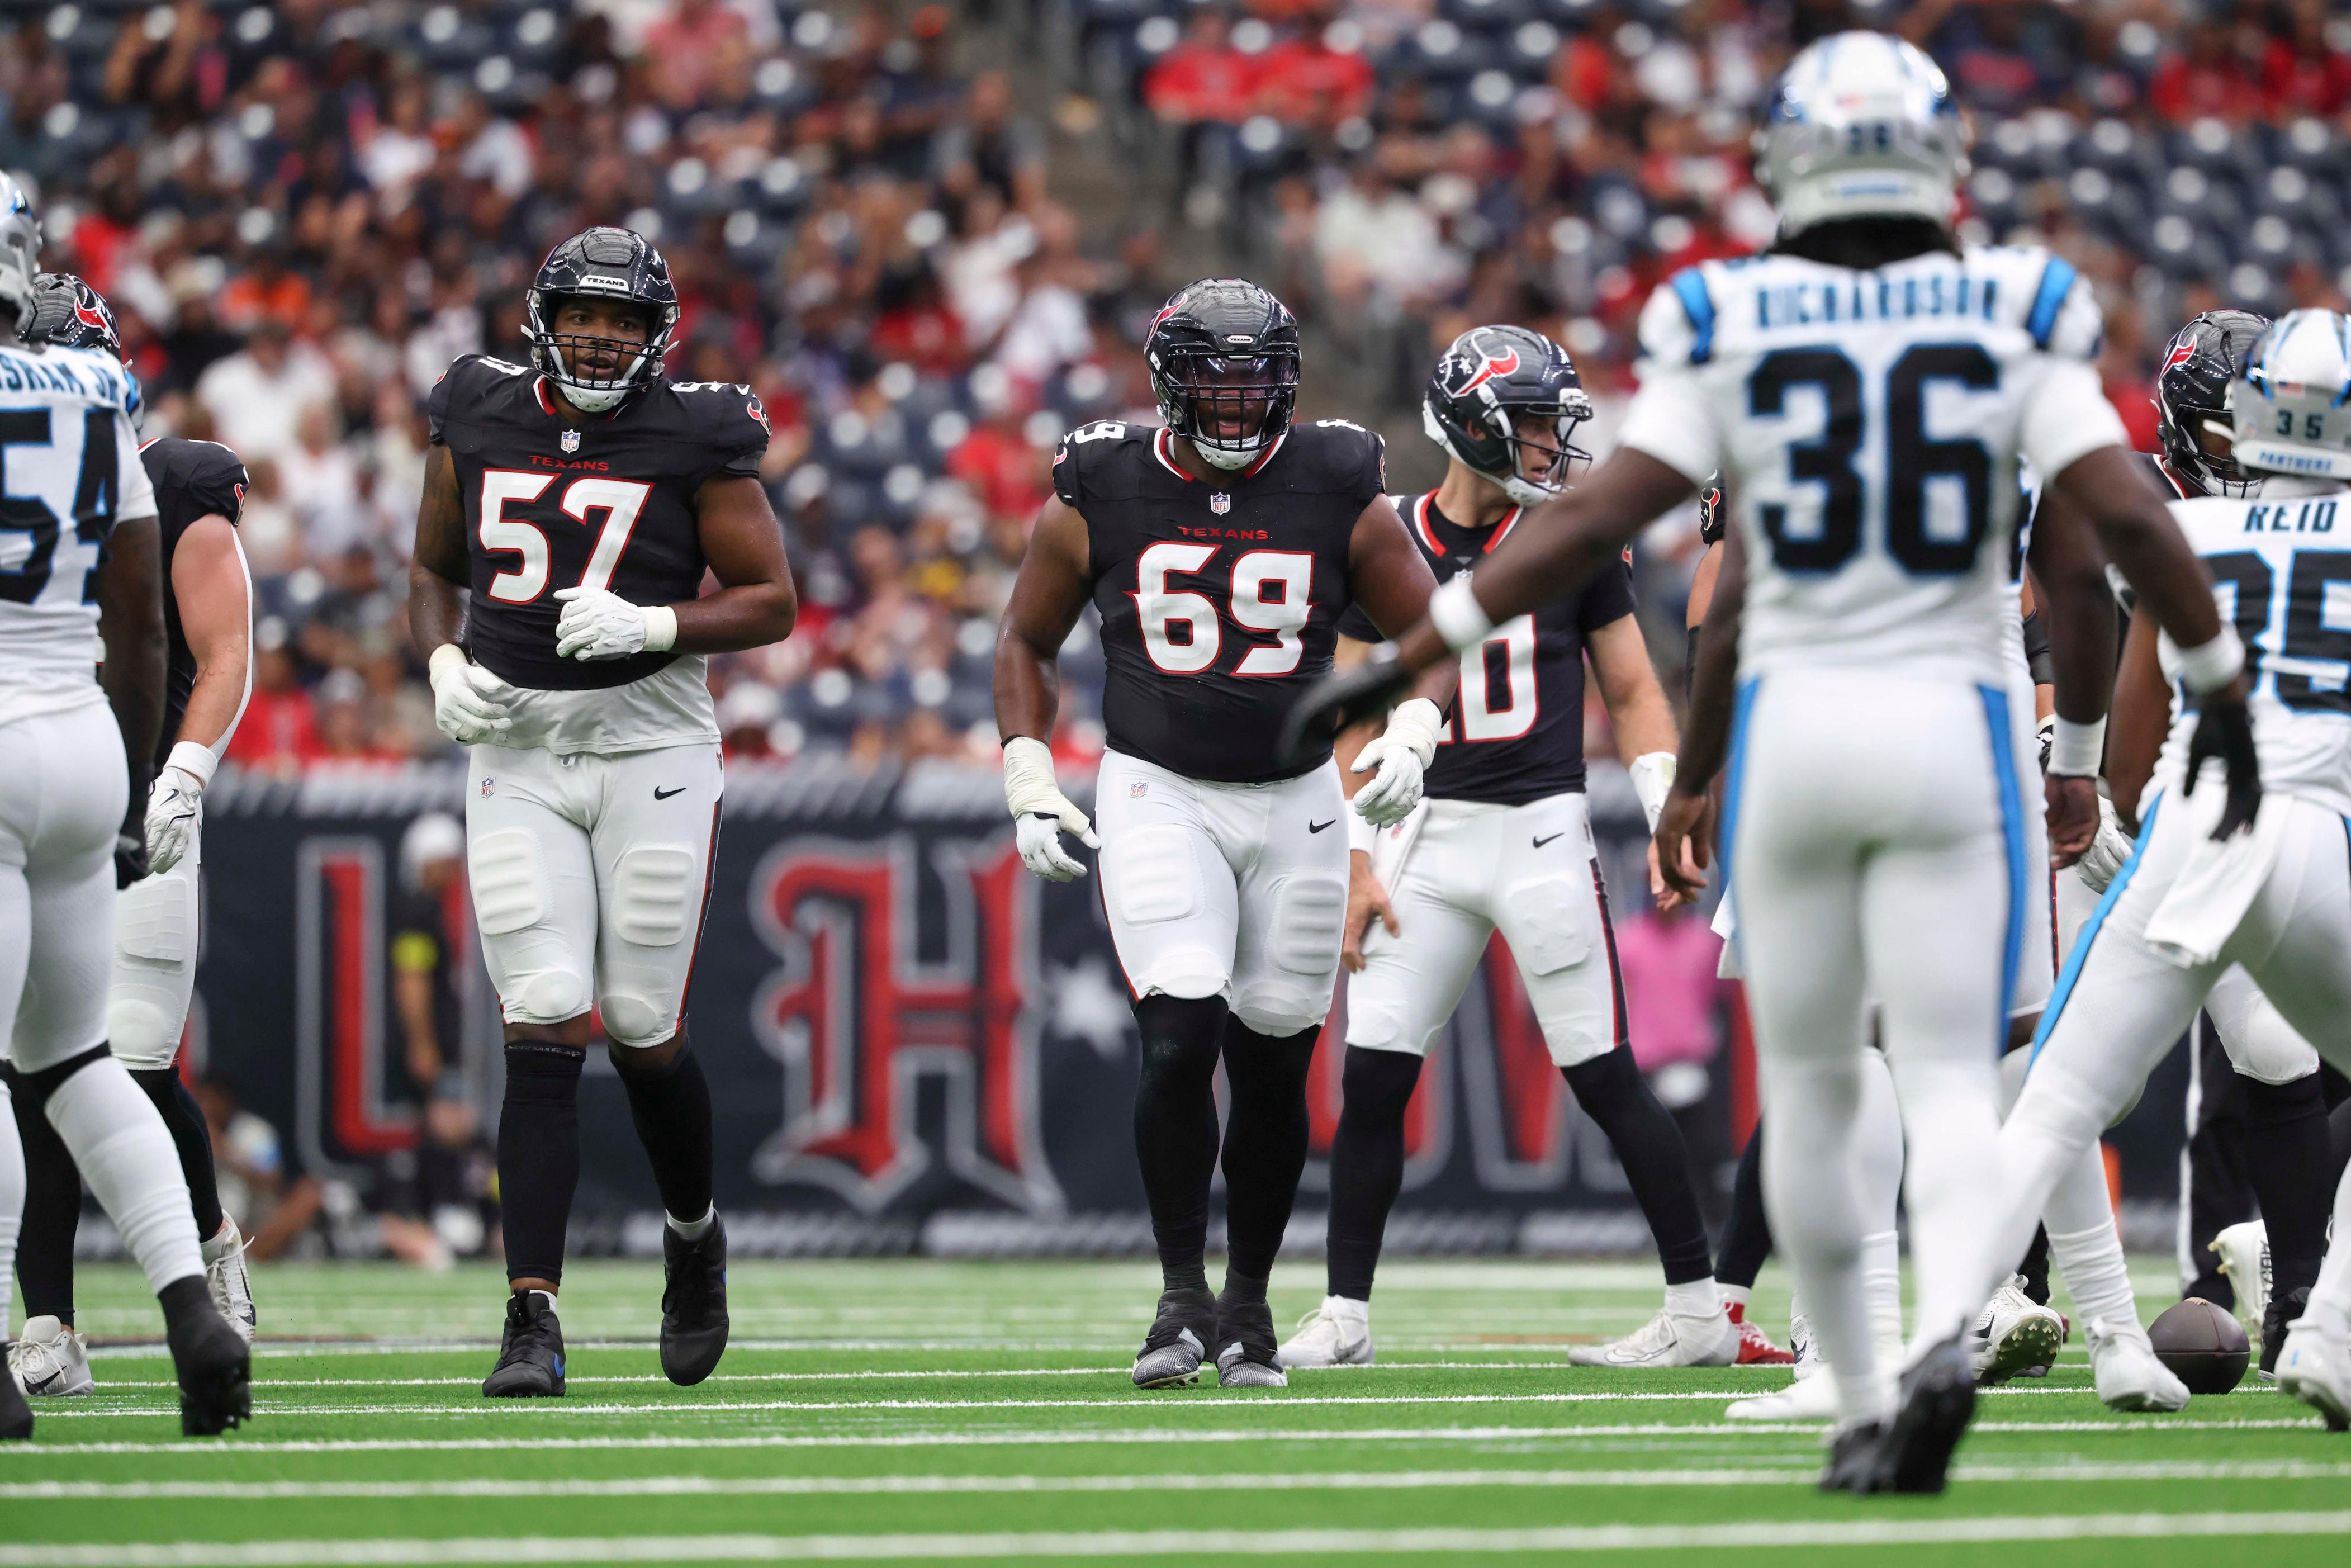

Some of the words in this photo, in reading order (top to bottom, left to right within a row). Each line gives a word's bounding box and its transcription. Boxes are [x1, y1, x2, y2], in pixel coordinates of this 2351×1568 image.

[586, 278, 624, 286] TEXANS
[1757, 274, 1997, 328] RICHARDSON
[0, 352, 86, 395] SHAM
[2276, 409, 2324, 440] 35
[563, 439, 576, 449] NFL
[1747, 343, 2001, 575] 36
[2260, 451, 2333, 472] PANTHERS
[529, 456, 610, 471] TEXANS
[0, 406, 120, 606] 54
[1214, 503, 1227, 511] NFL
[2244, 501, 2338, 532] REID
[478, 468, 656, 605] 57
[1177, 526, 1269, 540] TEXANS
[1122, 541, 1321, 678] 69
[2179, 548, 2351, 716] 35
[1437, 612, 1539, 745] 0
